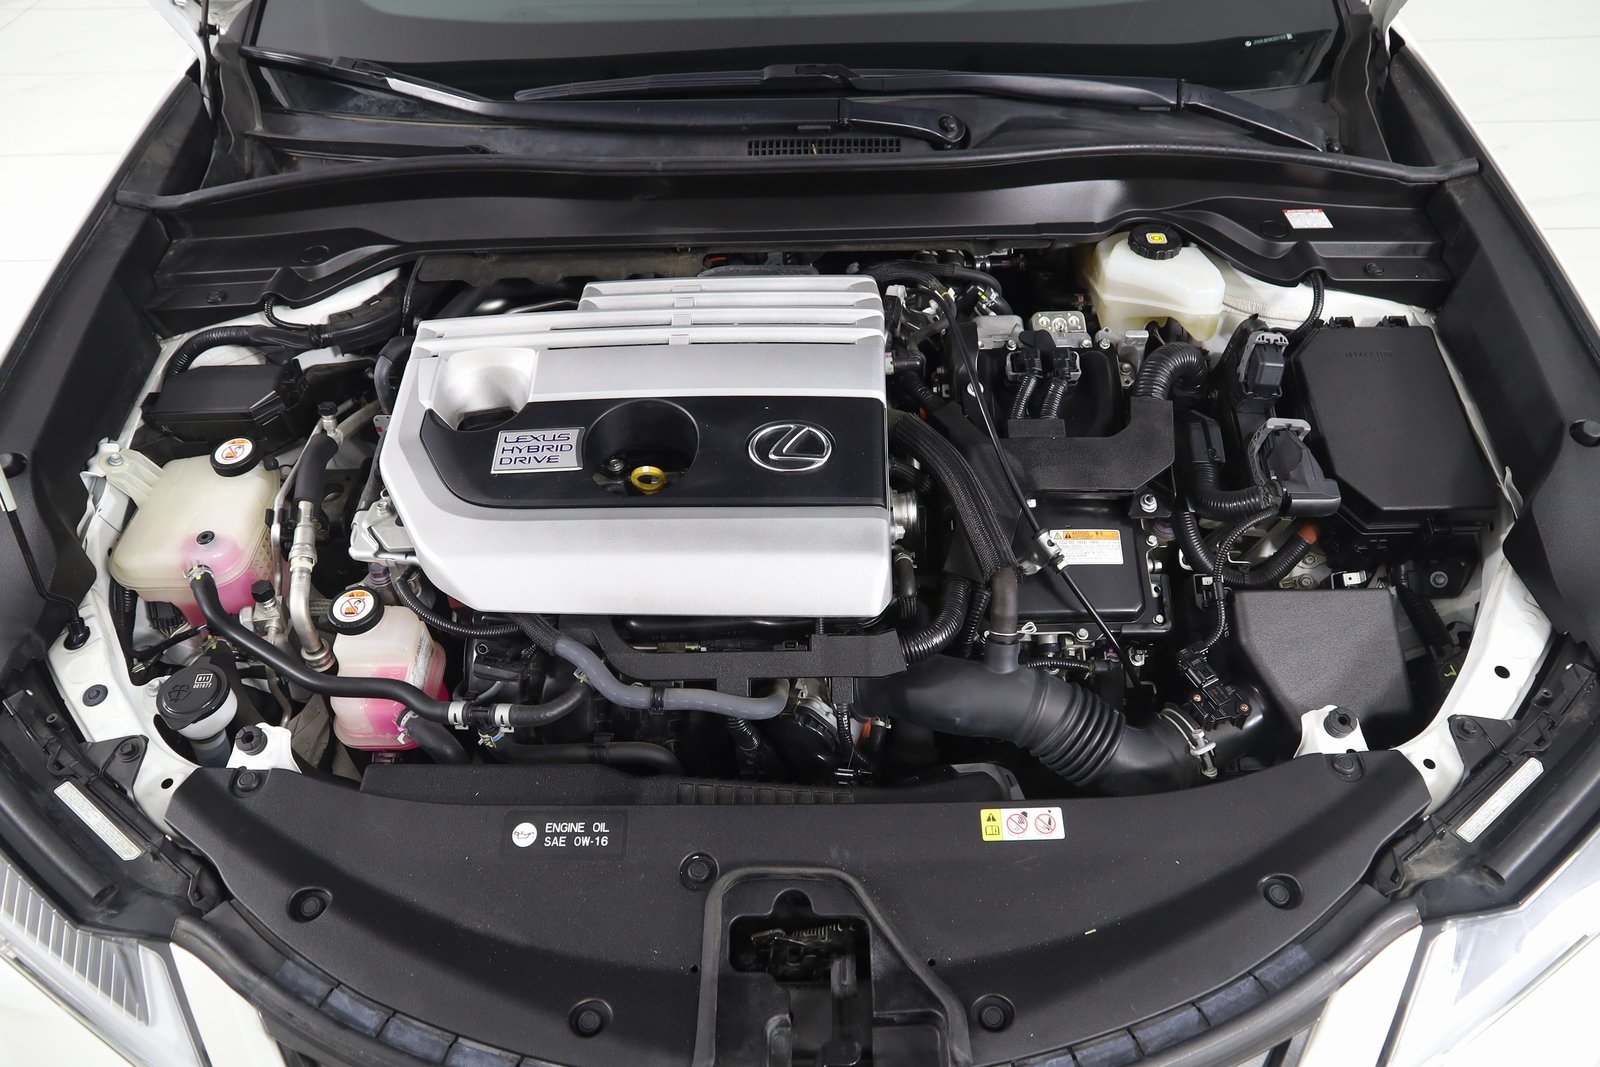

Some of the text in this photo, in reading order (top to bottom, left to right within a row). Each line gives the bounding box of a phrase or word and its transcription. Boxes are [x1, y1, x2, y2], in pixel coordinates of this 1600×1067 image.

[504, 433, 570, 443] LEXUS
[501, 444, 573, 454] HYBRID
[499, 455, 560, 465] DRIVE
[545, 822, 610, 833] ENGINE OIL
[543, 836, 567, 847] SAE
